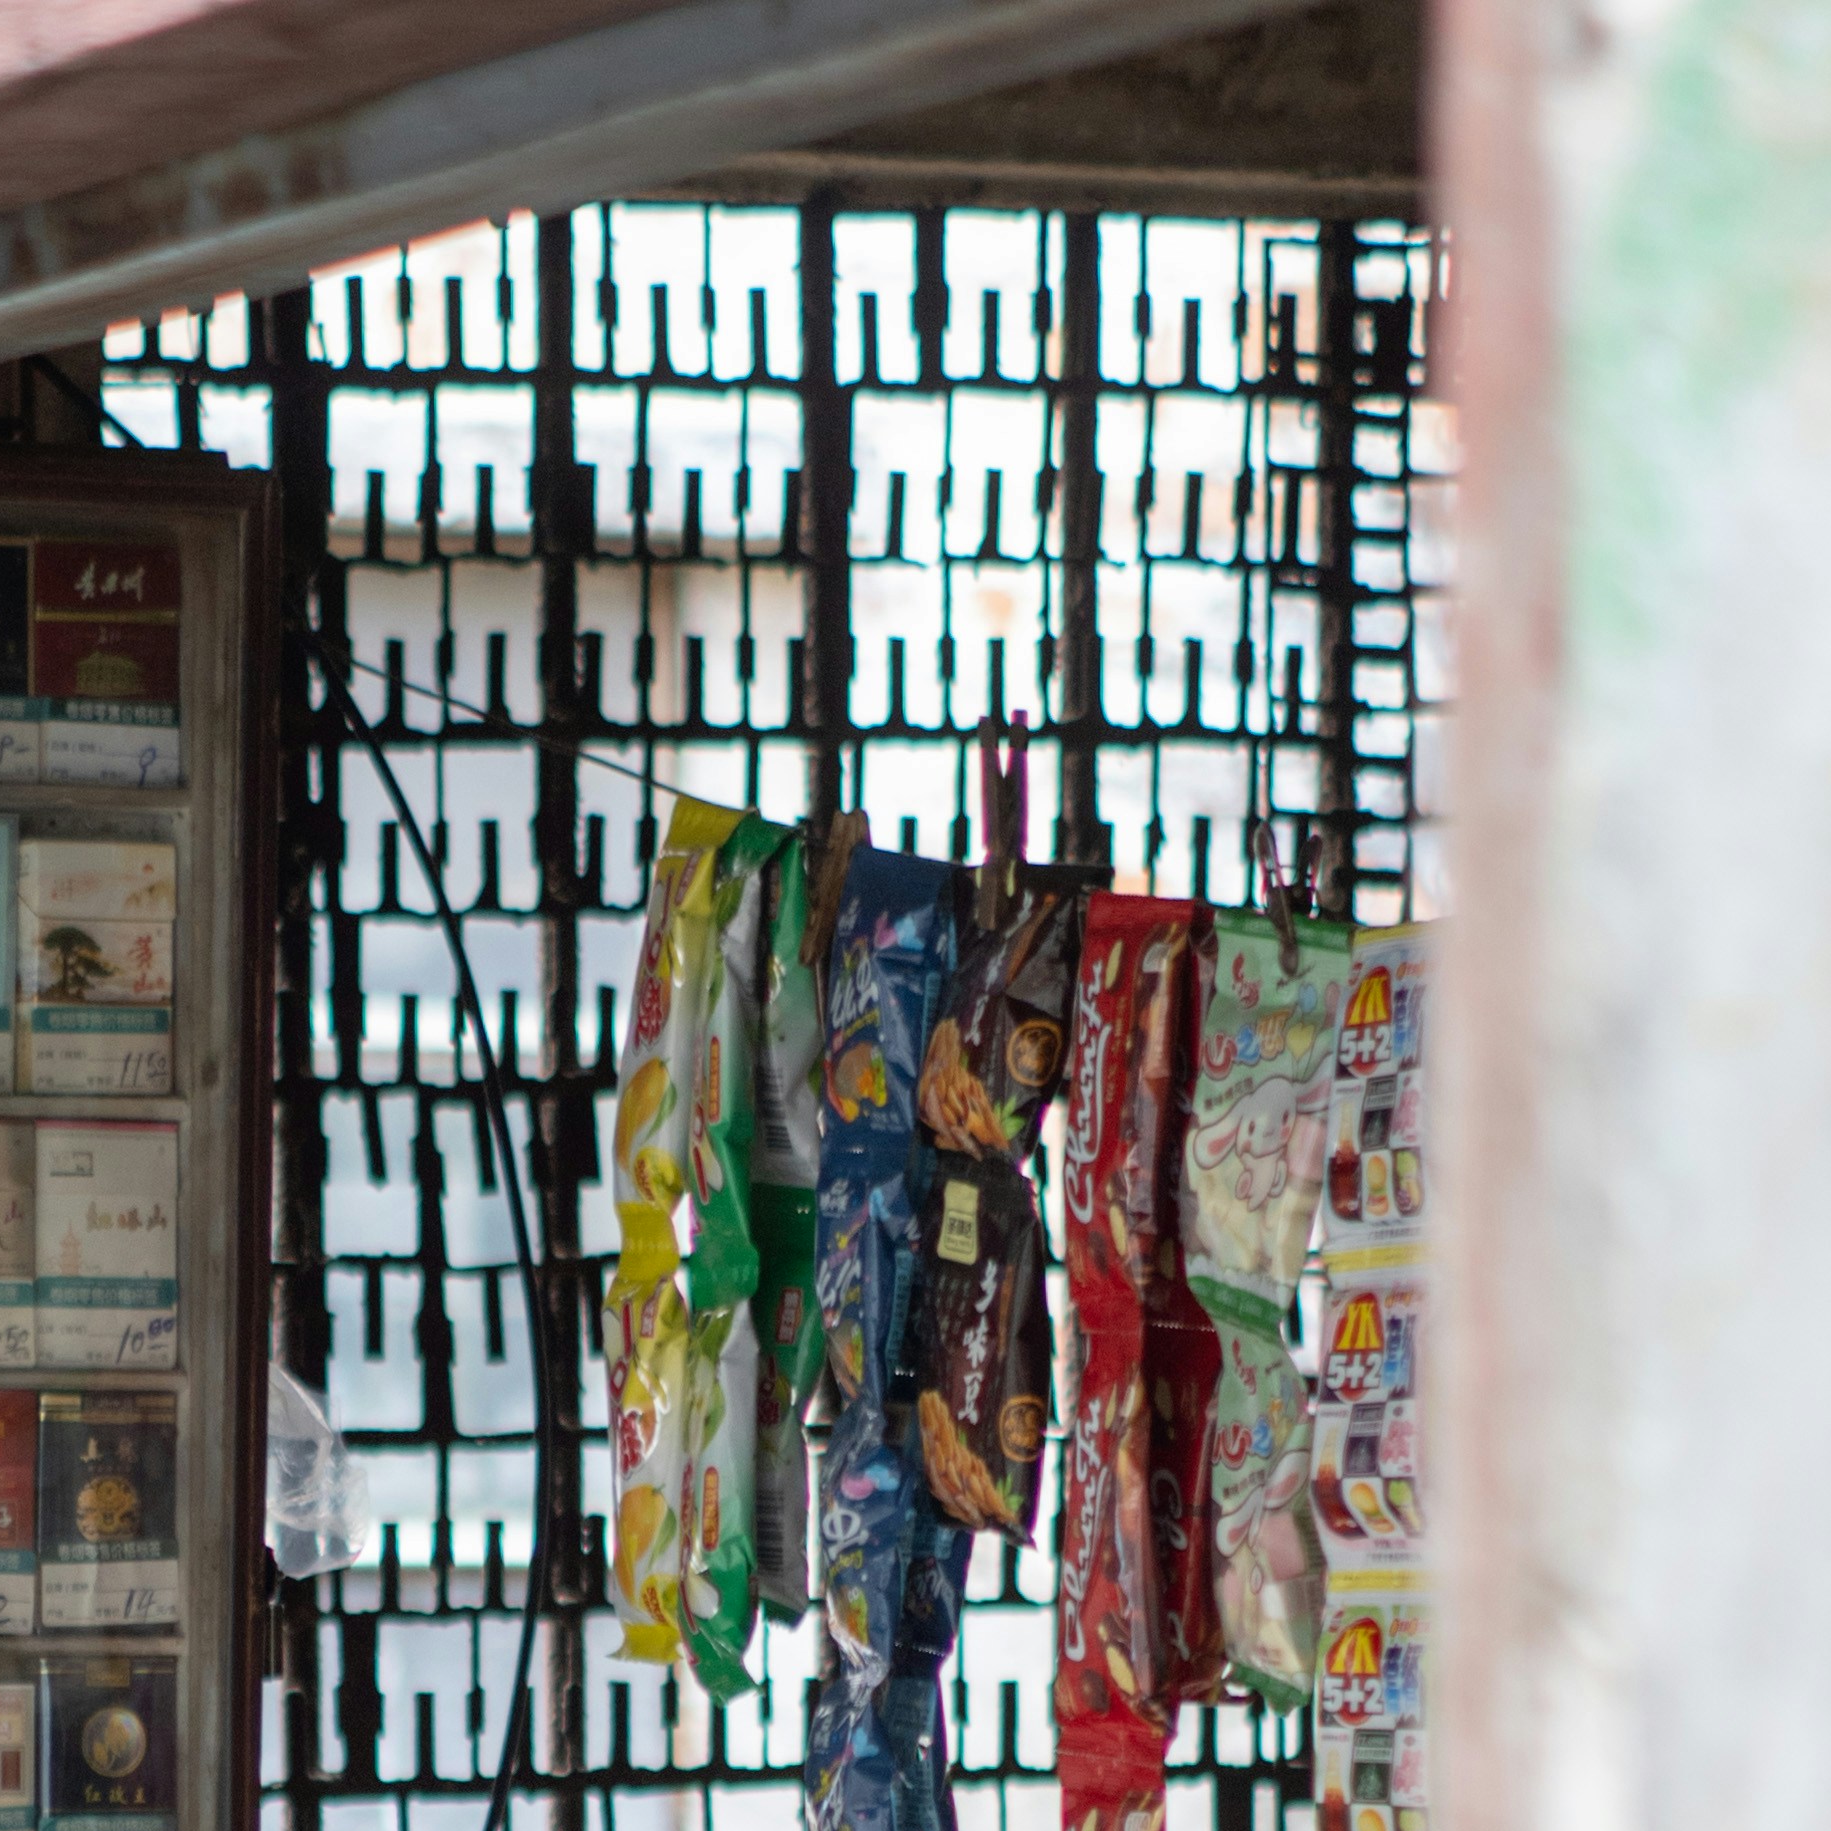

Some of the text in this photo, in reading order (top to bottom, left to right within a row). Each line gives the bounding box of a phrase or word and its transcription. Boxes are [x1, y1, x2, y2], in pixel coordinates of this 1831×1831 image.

[1339, 1023, 1394, 1063] 5+2
[1327, 1350, 1385, 1391] 5+2
[1322, 1675, 1386, 1716] 5+2
